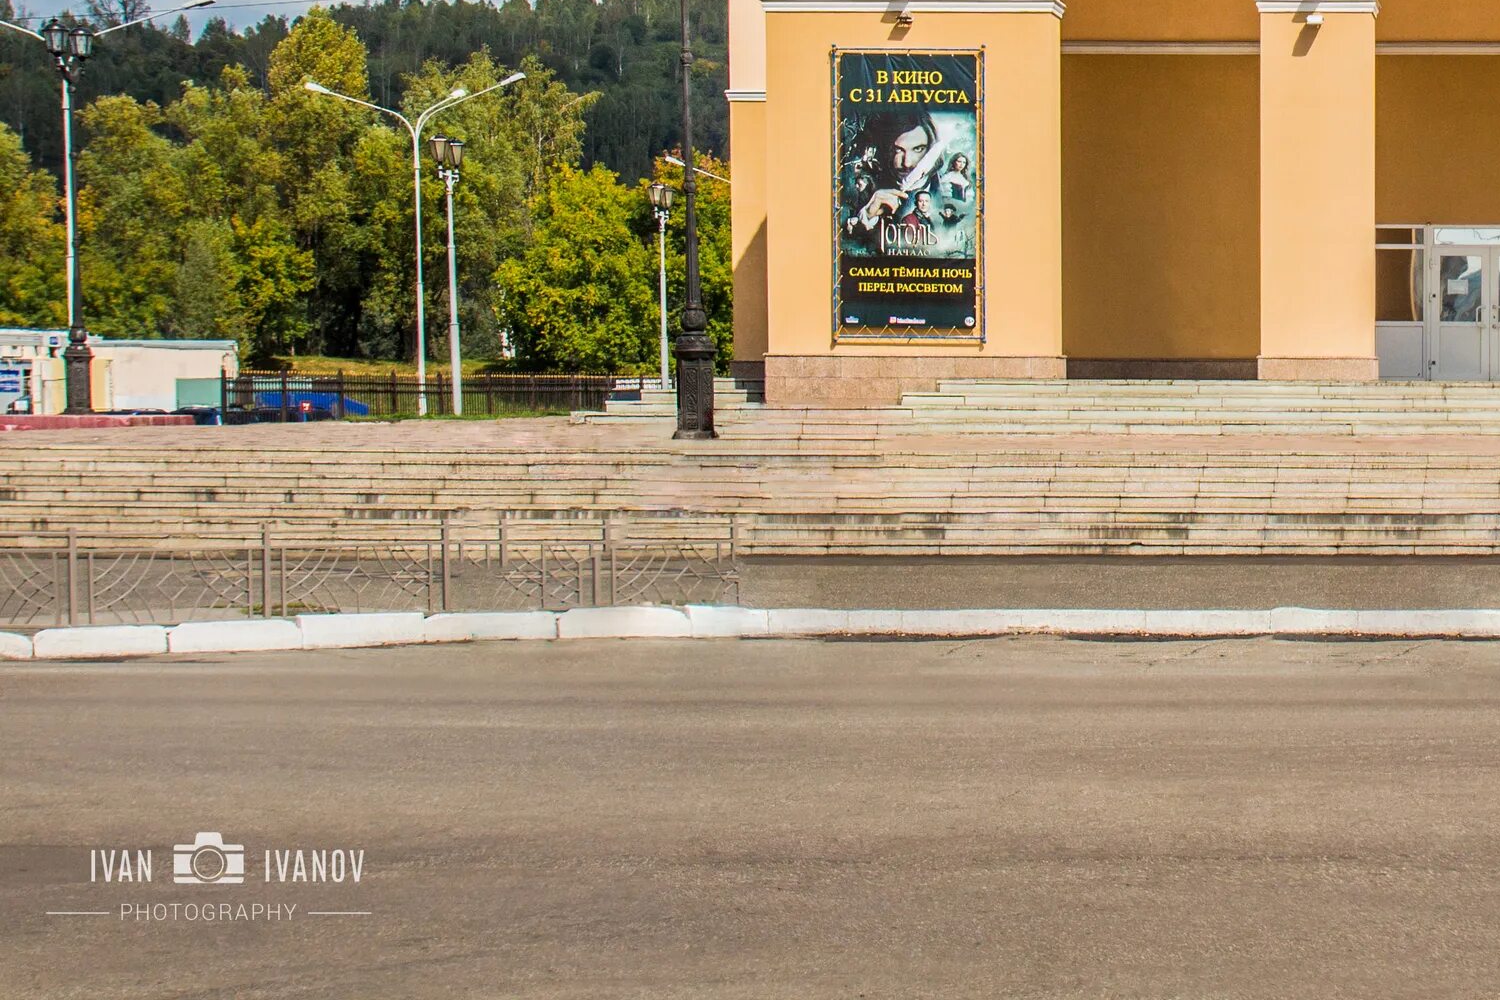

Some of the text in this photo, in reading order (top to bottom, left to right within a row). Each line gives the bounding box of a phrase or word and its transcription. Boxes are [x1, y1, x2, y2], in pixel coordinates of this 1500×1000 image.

[876, 70, 943, 85] В КИНО
[849, 88, 970, 104] С 31 АВГУСТА
[887, 248, 932, 256] НАЧАЛО
[849, 266, 973, 279] САМАЯ ТЁМНАЯ НОЧЬ
[858, 282, 963, 294] ПЕРЕД РАССВЕТОМ
